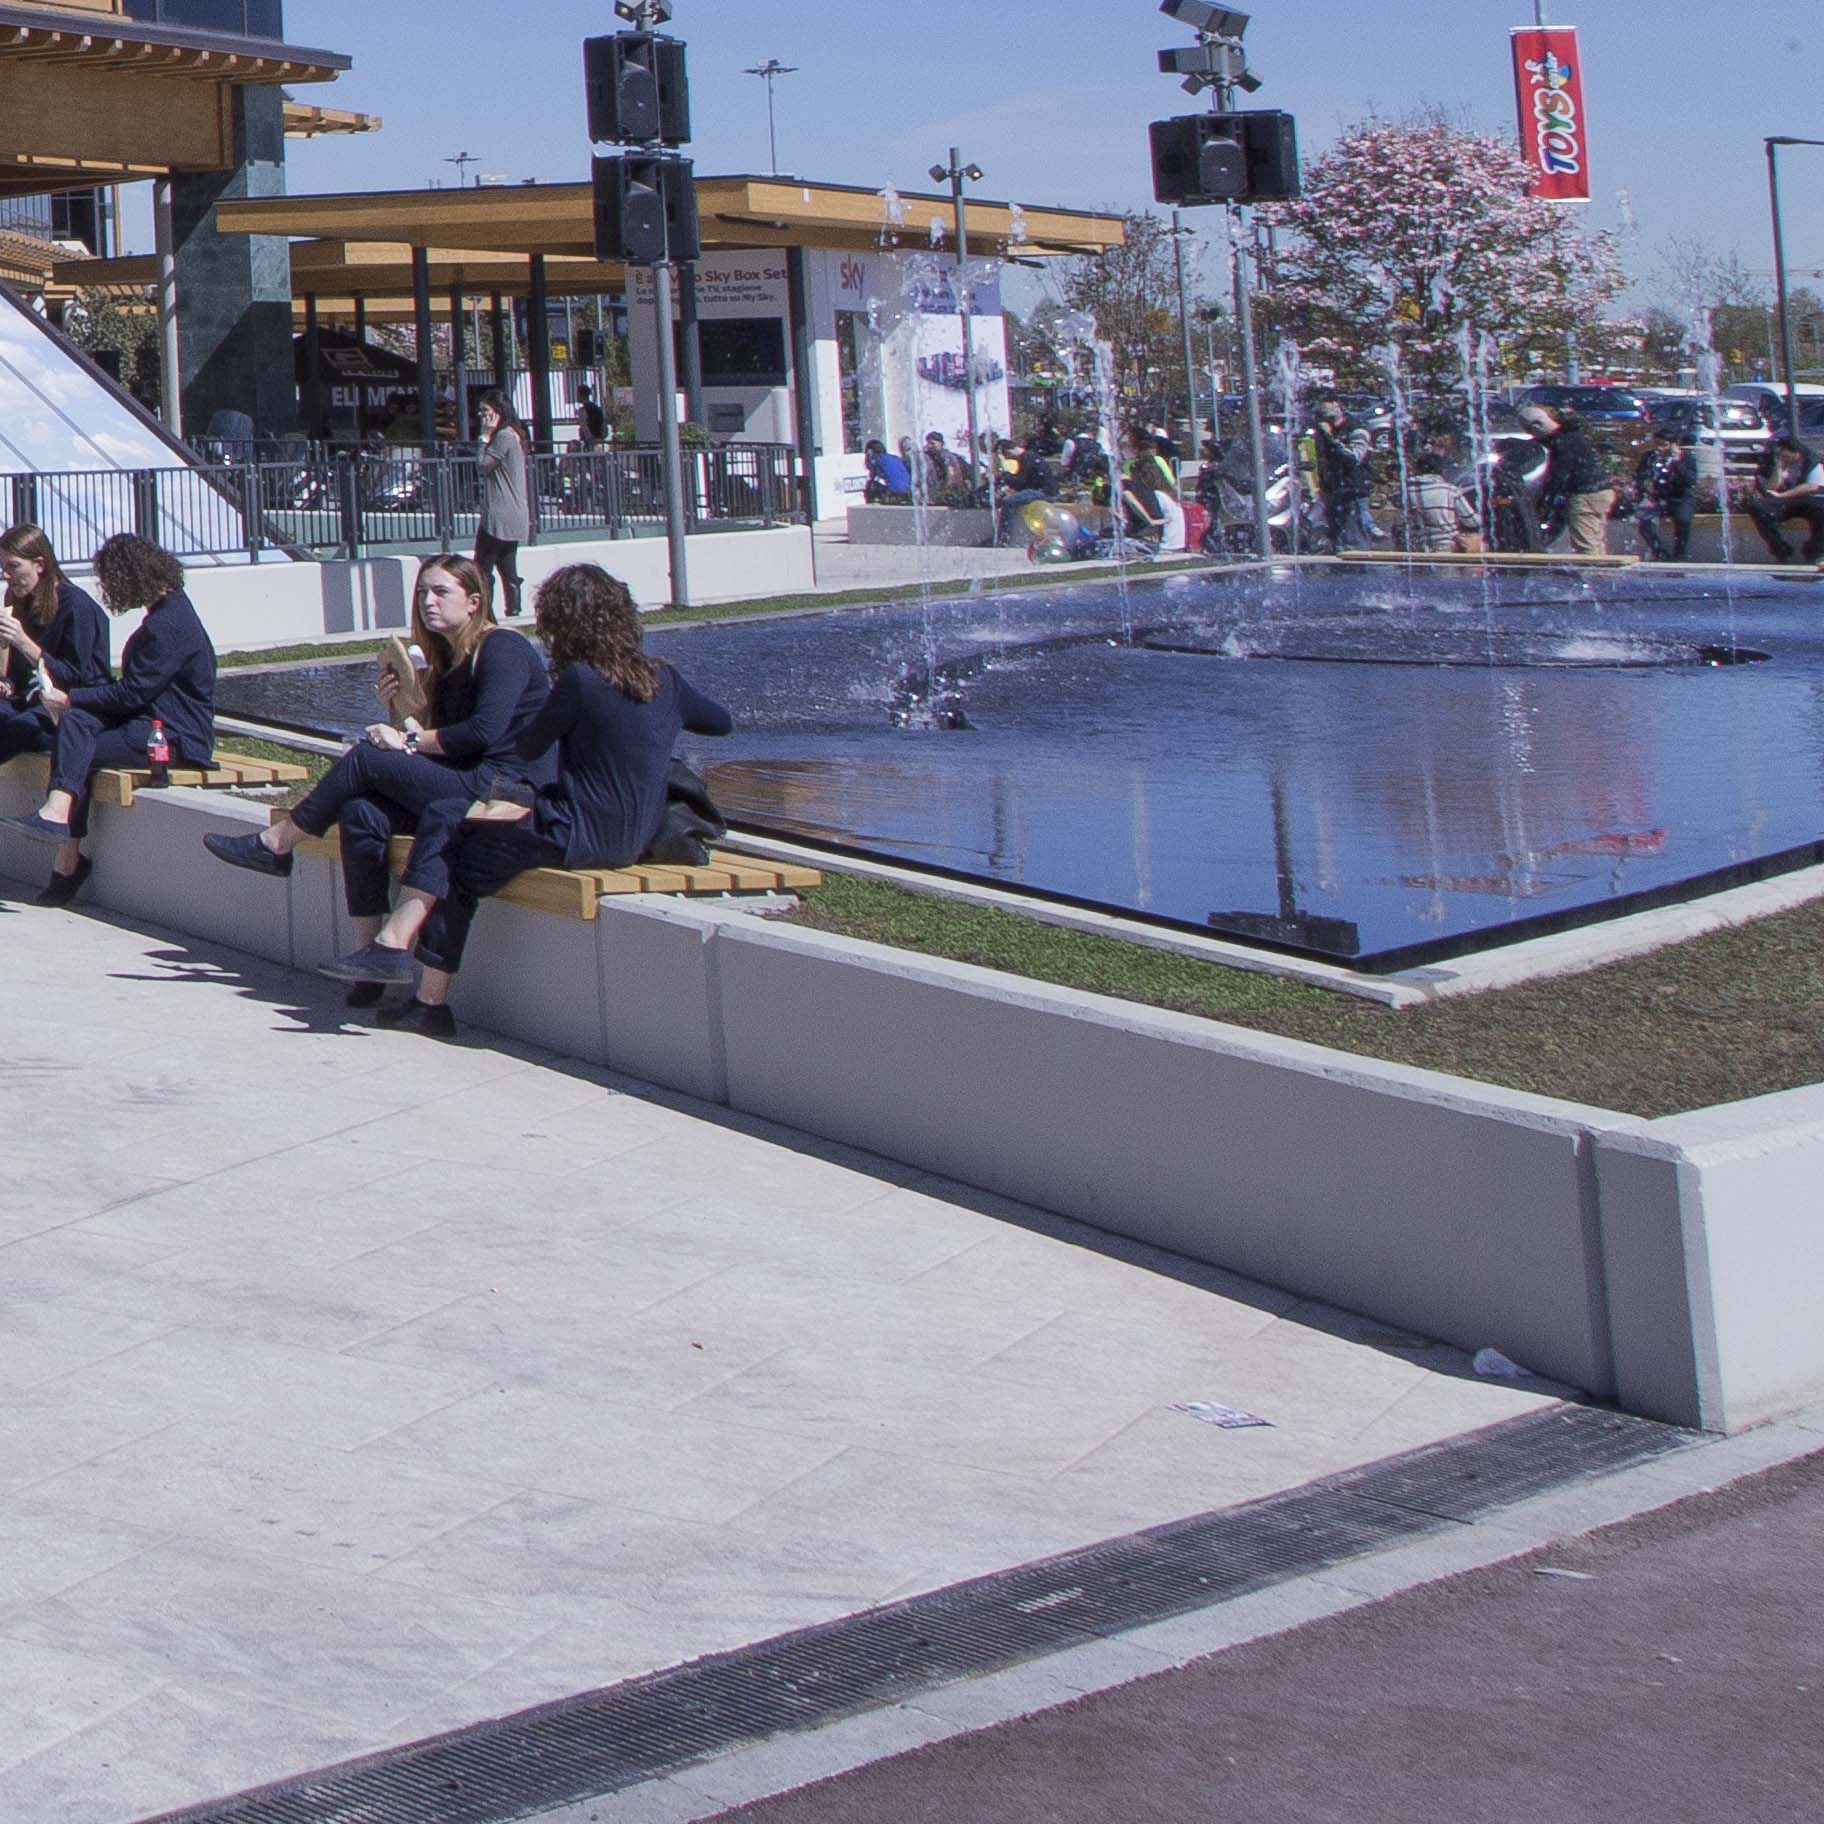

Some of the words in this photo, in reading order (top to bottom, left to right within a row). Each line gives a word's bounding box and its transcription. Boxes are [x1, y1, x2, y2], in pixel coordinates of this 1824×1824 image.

[1533, 88, 1580, 175] TOYS
[704, 270, 730, 284] Sky
[733, 269, 760, 281] Box
[840, 254, 865, 298] sky
